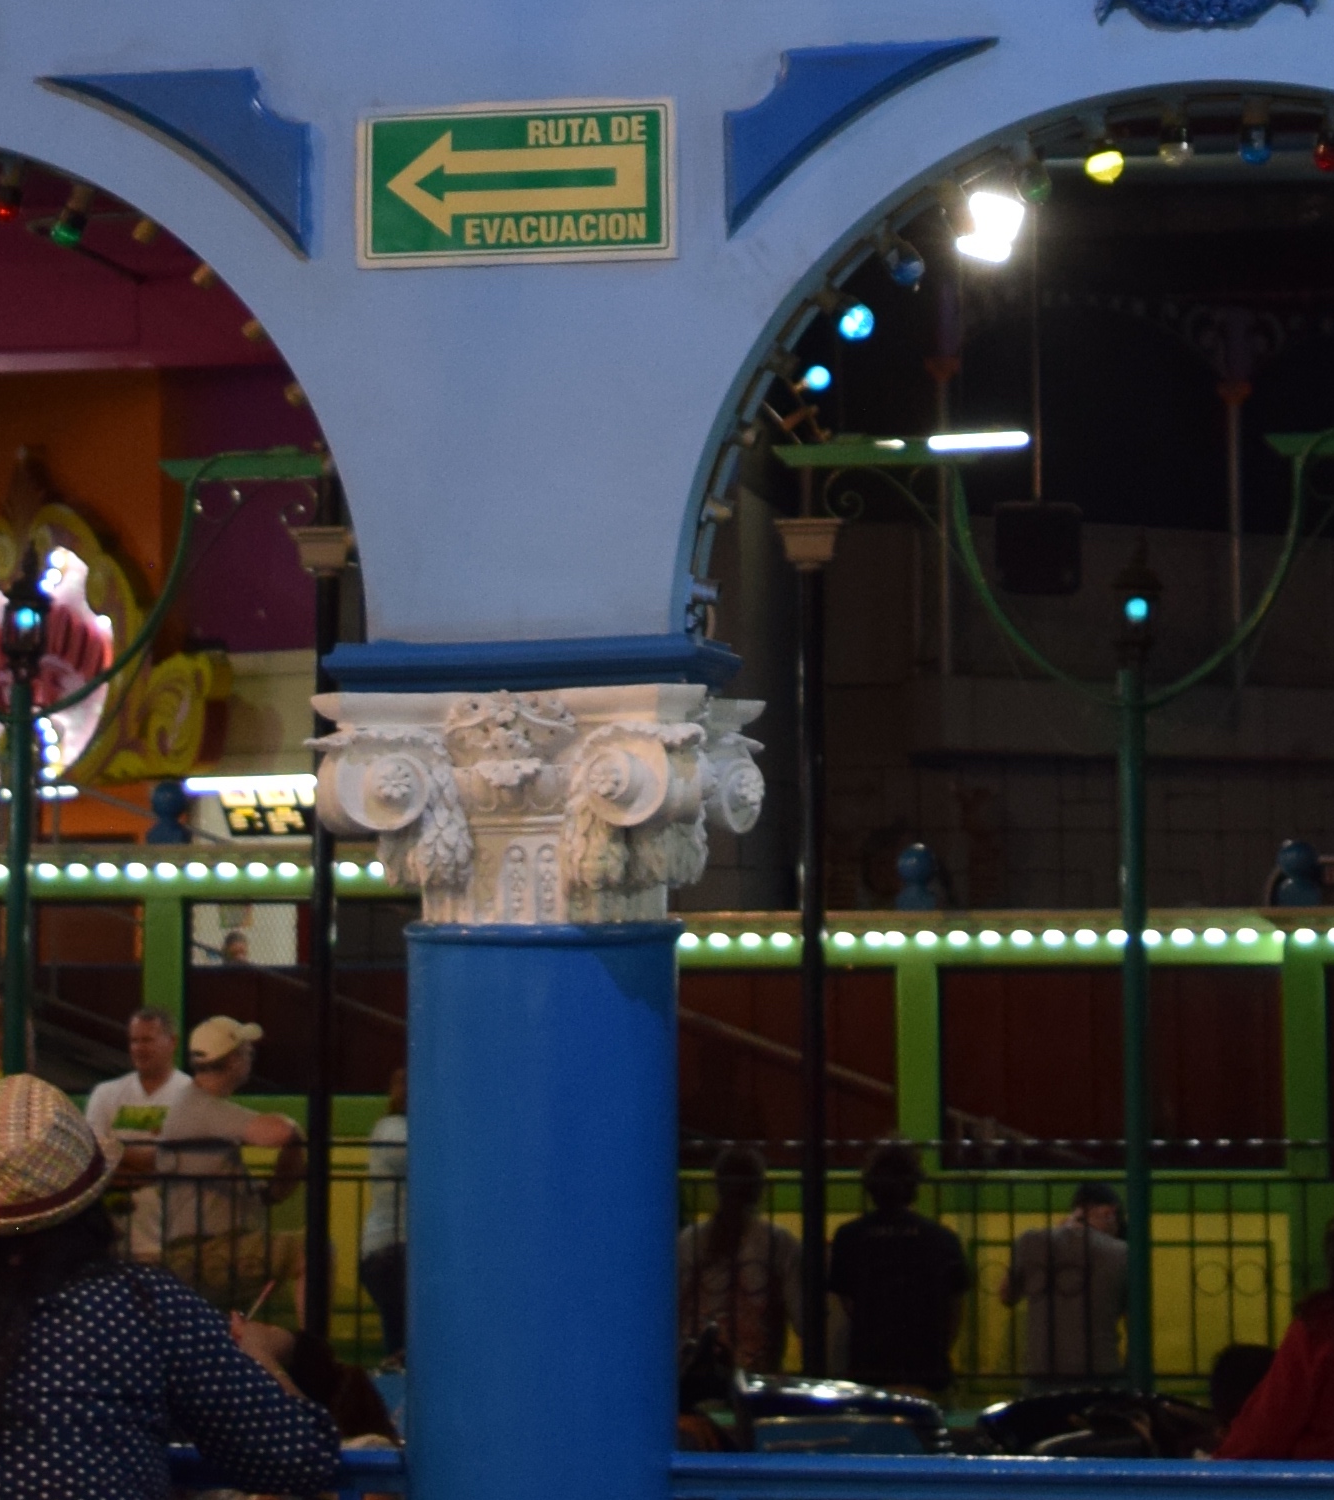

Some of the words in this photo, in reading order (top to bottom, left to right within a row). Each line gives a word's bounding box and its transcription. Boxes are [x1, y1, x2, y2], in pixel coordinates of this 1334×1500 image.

[526, 115, 602, 146] RUTA
[610, 114, 647, 142] DE
[465, 212, 647, 245] EVACUACION
